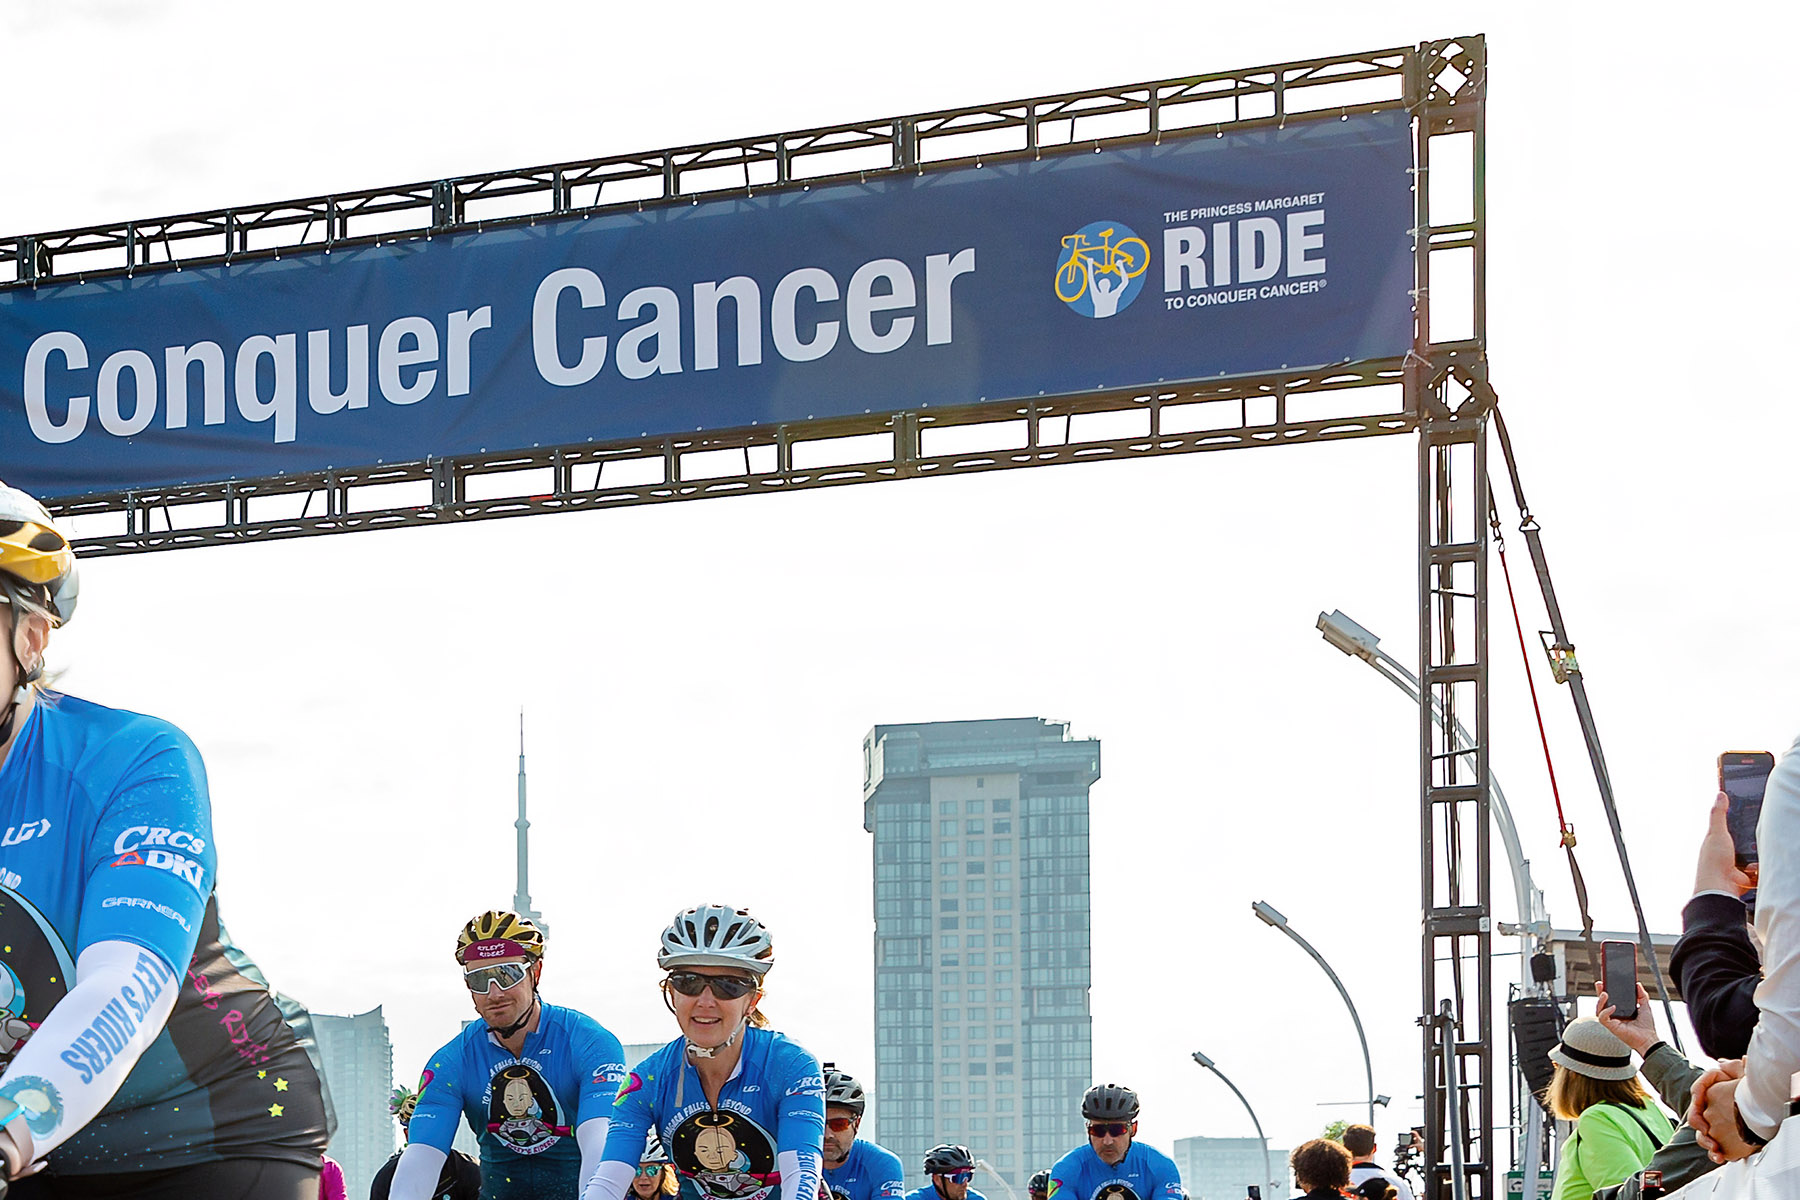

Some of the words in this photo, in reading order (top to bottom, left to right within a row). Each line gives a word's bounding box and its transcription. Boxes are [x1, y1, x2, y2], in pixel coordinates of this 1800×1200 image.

[1163, 210, 1188, 223] THE
[1190, 202, 1252, 219] PRINCESS
[1254, 192, 1325, 212] MARGARET
[1163, 209, 1326, 293] RIDE
[1164, 297, 1184, 311] TO
[1186, 288, 1257, 307] CONQUER
[22, 305, 493, 445] Conquer
[531, 246, 977, 388] Cancer
[114, 826, 206, 855] CRCS
[60, 996, 137, 1085] RIDERS
[684, 1101, 706, 1116] FALLS
[720, 1098, 753, 1116] BEYOND
